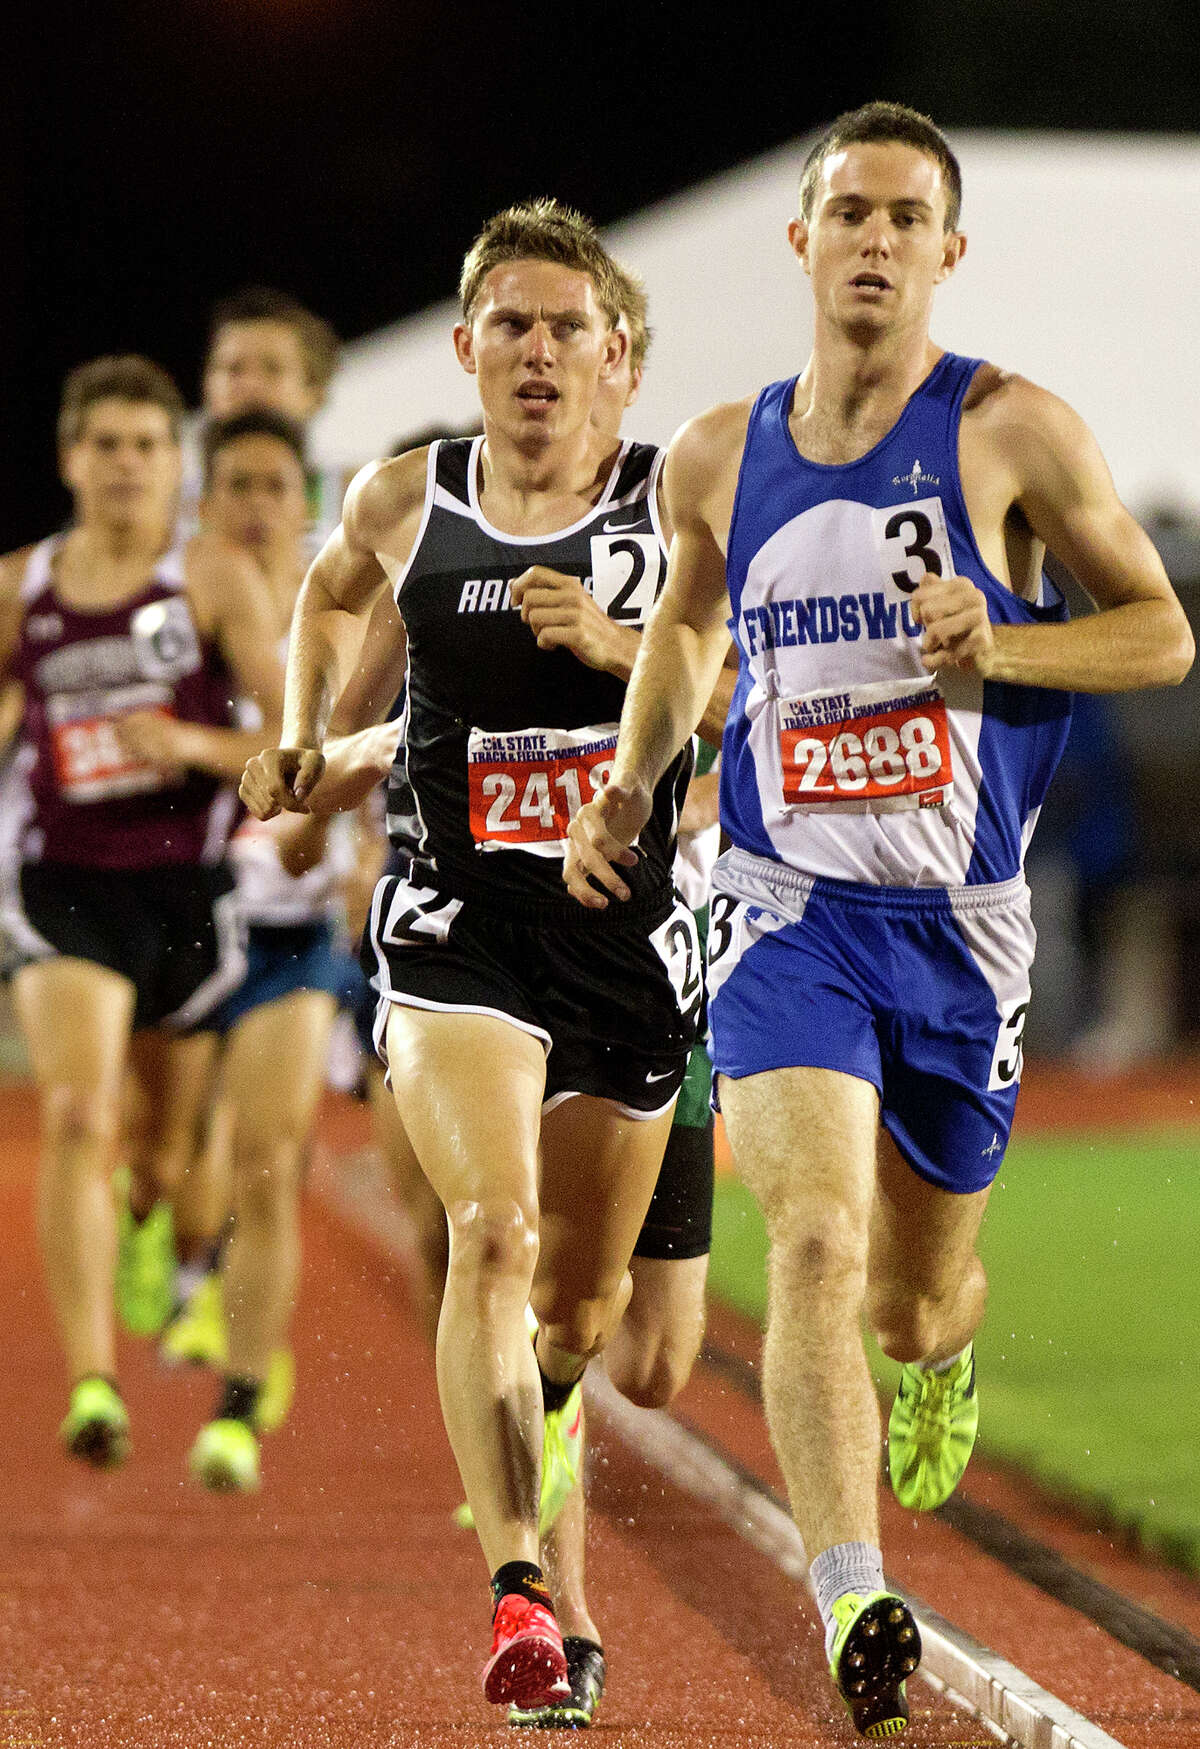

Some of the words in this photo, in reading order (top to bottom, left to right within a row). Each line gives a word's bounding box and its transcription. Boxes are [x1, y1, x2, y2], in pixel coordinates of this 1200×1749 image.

[607, 538, 645, 620] 2
[885, 510, 942, 593] 3
[743, 592, 926, 657] FRIENDSWO
[784, 715, 815, 730] TRACK
[824, 707, 851, 725] FIELD
[853, 689, 940, 719] CHAMPIONSHIPS
[811, 693, 851, 714] STATE
[472, 751, 507, 763] TRACK
[517, 750, 545, 762] FIELD
[547, 735, 619, 761] CHAMPIONSHI
[506, 735, 547, 751] STATE
[794, 716, 942, 792] 2688
[664, 919, 701, 1001] 2
[709, 893, 740, 967] 3
[998, 1002, 1029, 1082] 3
